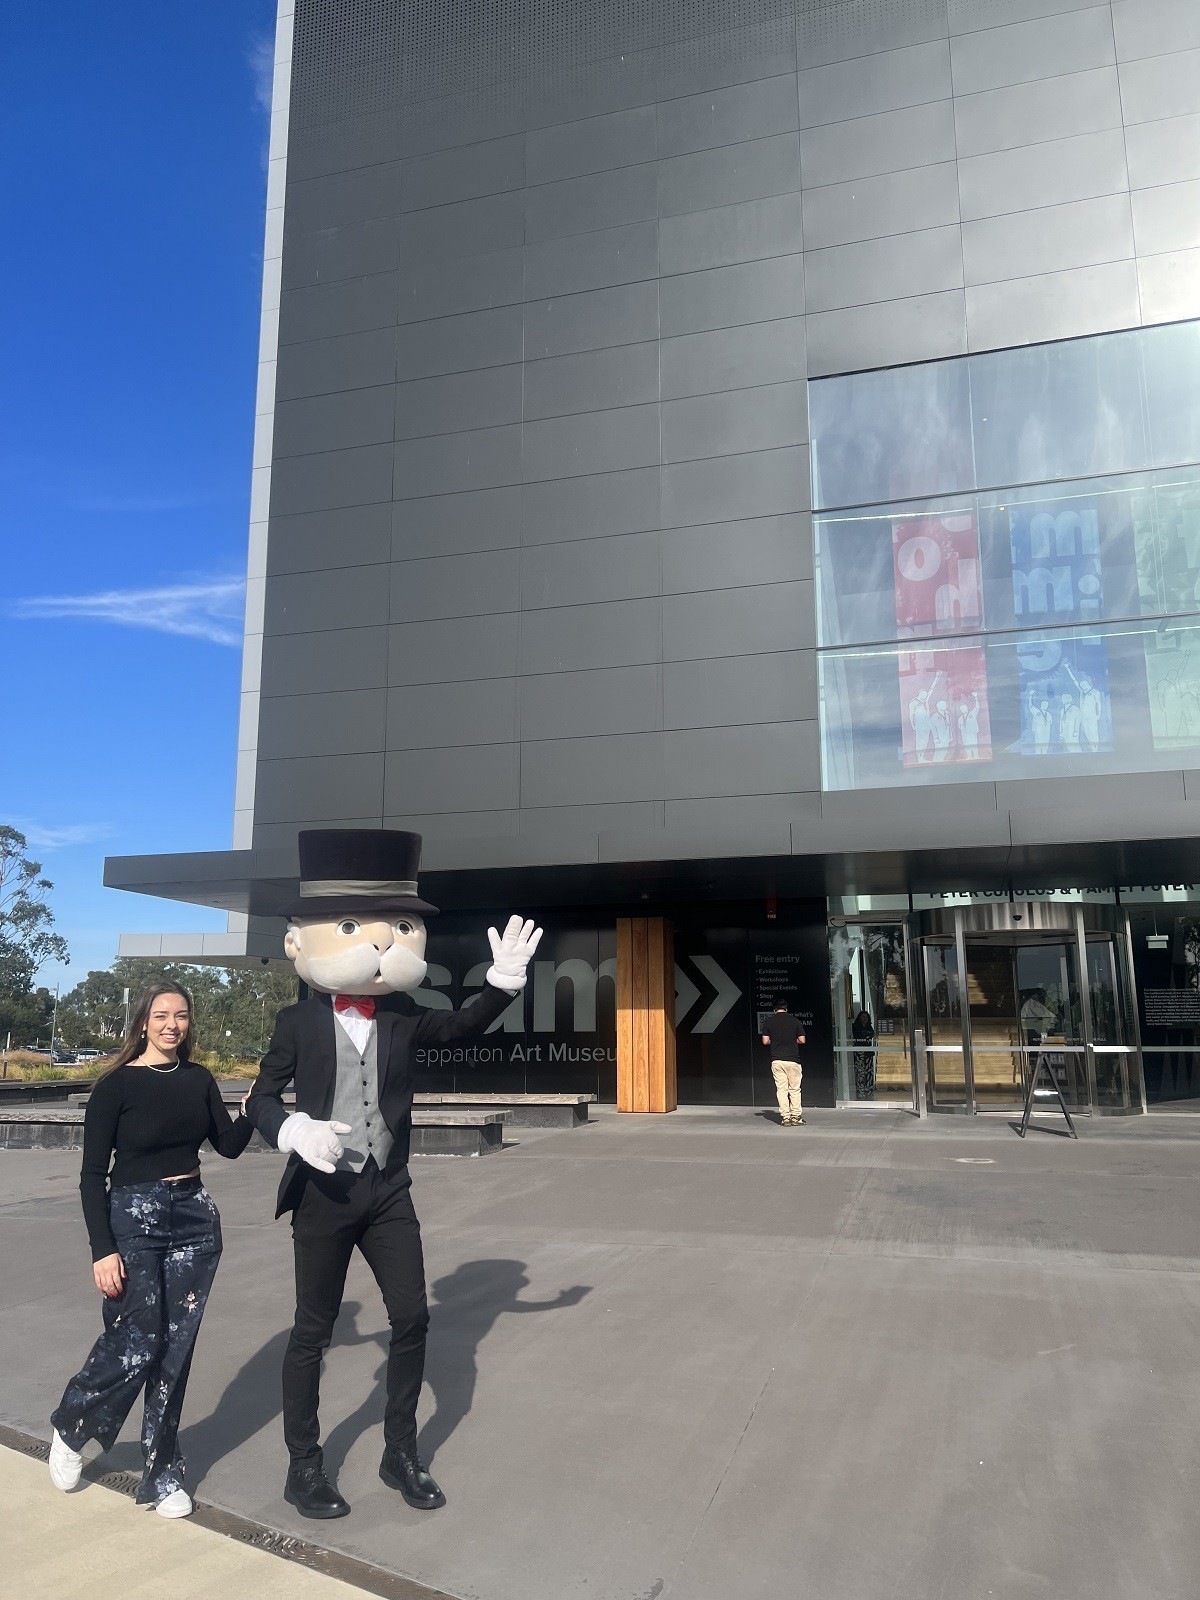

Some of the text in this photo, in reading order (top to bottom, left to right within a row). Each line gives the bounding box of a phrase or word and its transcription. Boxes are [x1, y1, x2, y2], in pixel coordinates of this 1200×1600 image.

[755, 954, 800, 964] Free entry
[415, 1043, 618, 1067] epparton Art Museu
